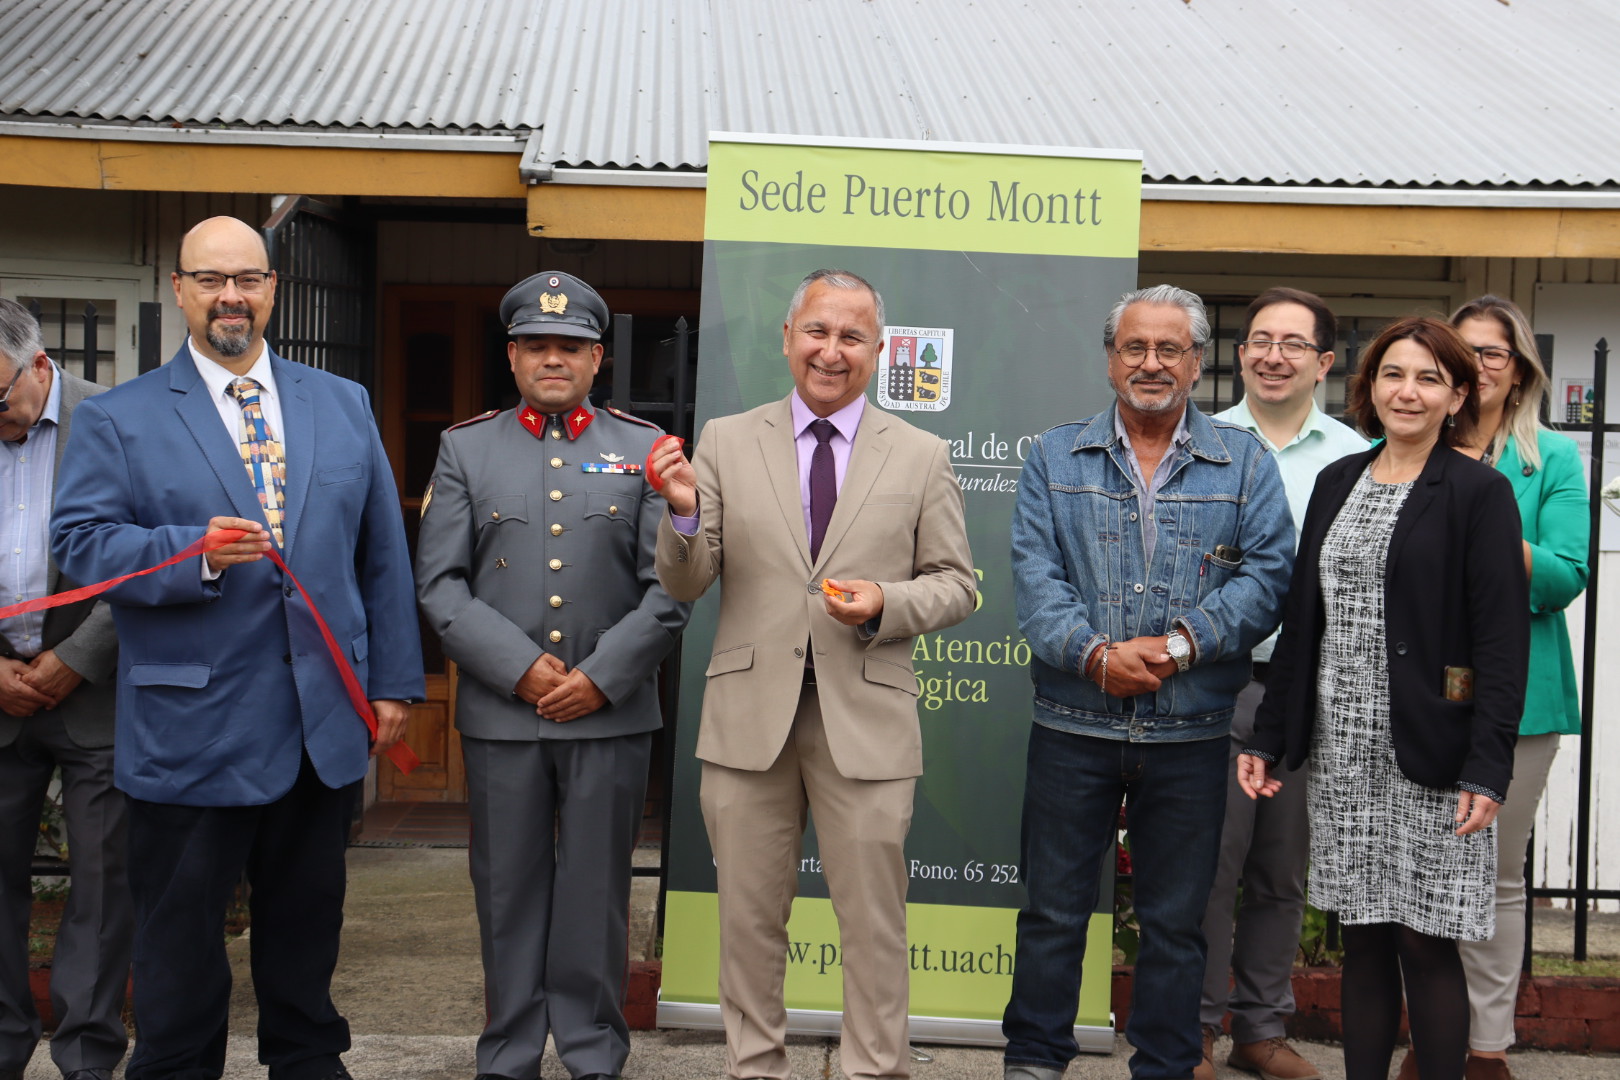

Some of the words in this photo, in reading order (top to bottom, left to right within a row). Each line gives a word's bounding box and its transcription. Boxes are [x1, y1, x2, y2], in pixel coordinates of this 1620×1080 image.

[740, 169, 826, 214] Sede
[842, 174, 970, 220] Puerto
[986, 180, 1102, 226] Montt
[888, 328, 918, 336] LIBERTAS
[918, 329, 946, 337] CAPITUR
[942, 371, 950, 394] CHILE
[904, 401, 937, 410] AUSTRAL
[939, 396, 949, 407] DE
[981, 432, 1009, 460] de
[912, 634, 1032, 666] Atenció
[909, 859, 958, 881] Fono:
[963, 860, 985, 883] 65
[990, 864, 1019, 885] 252
